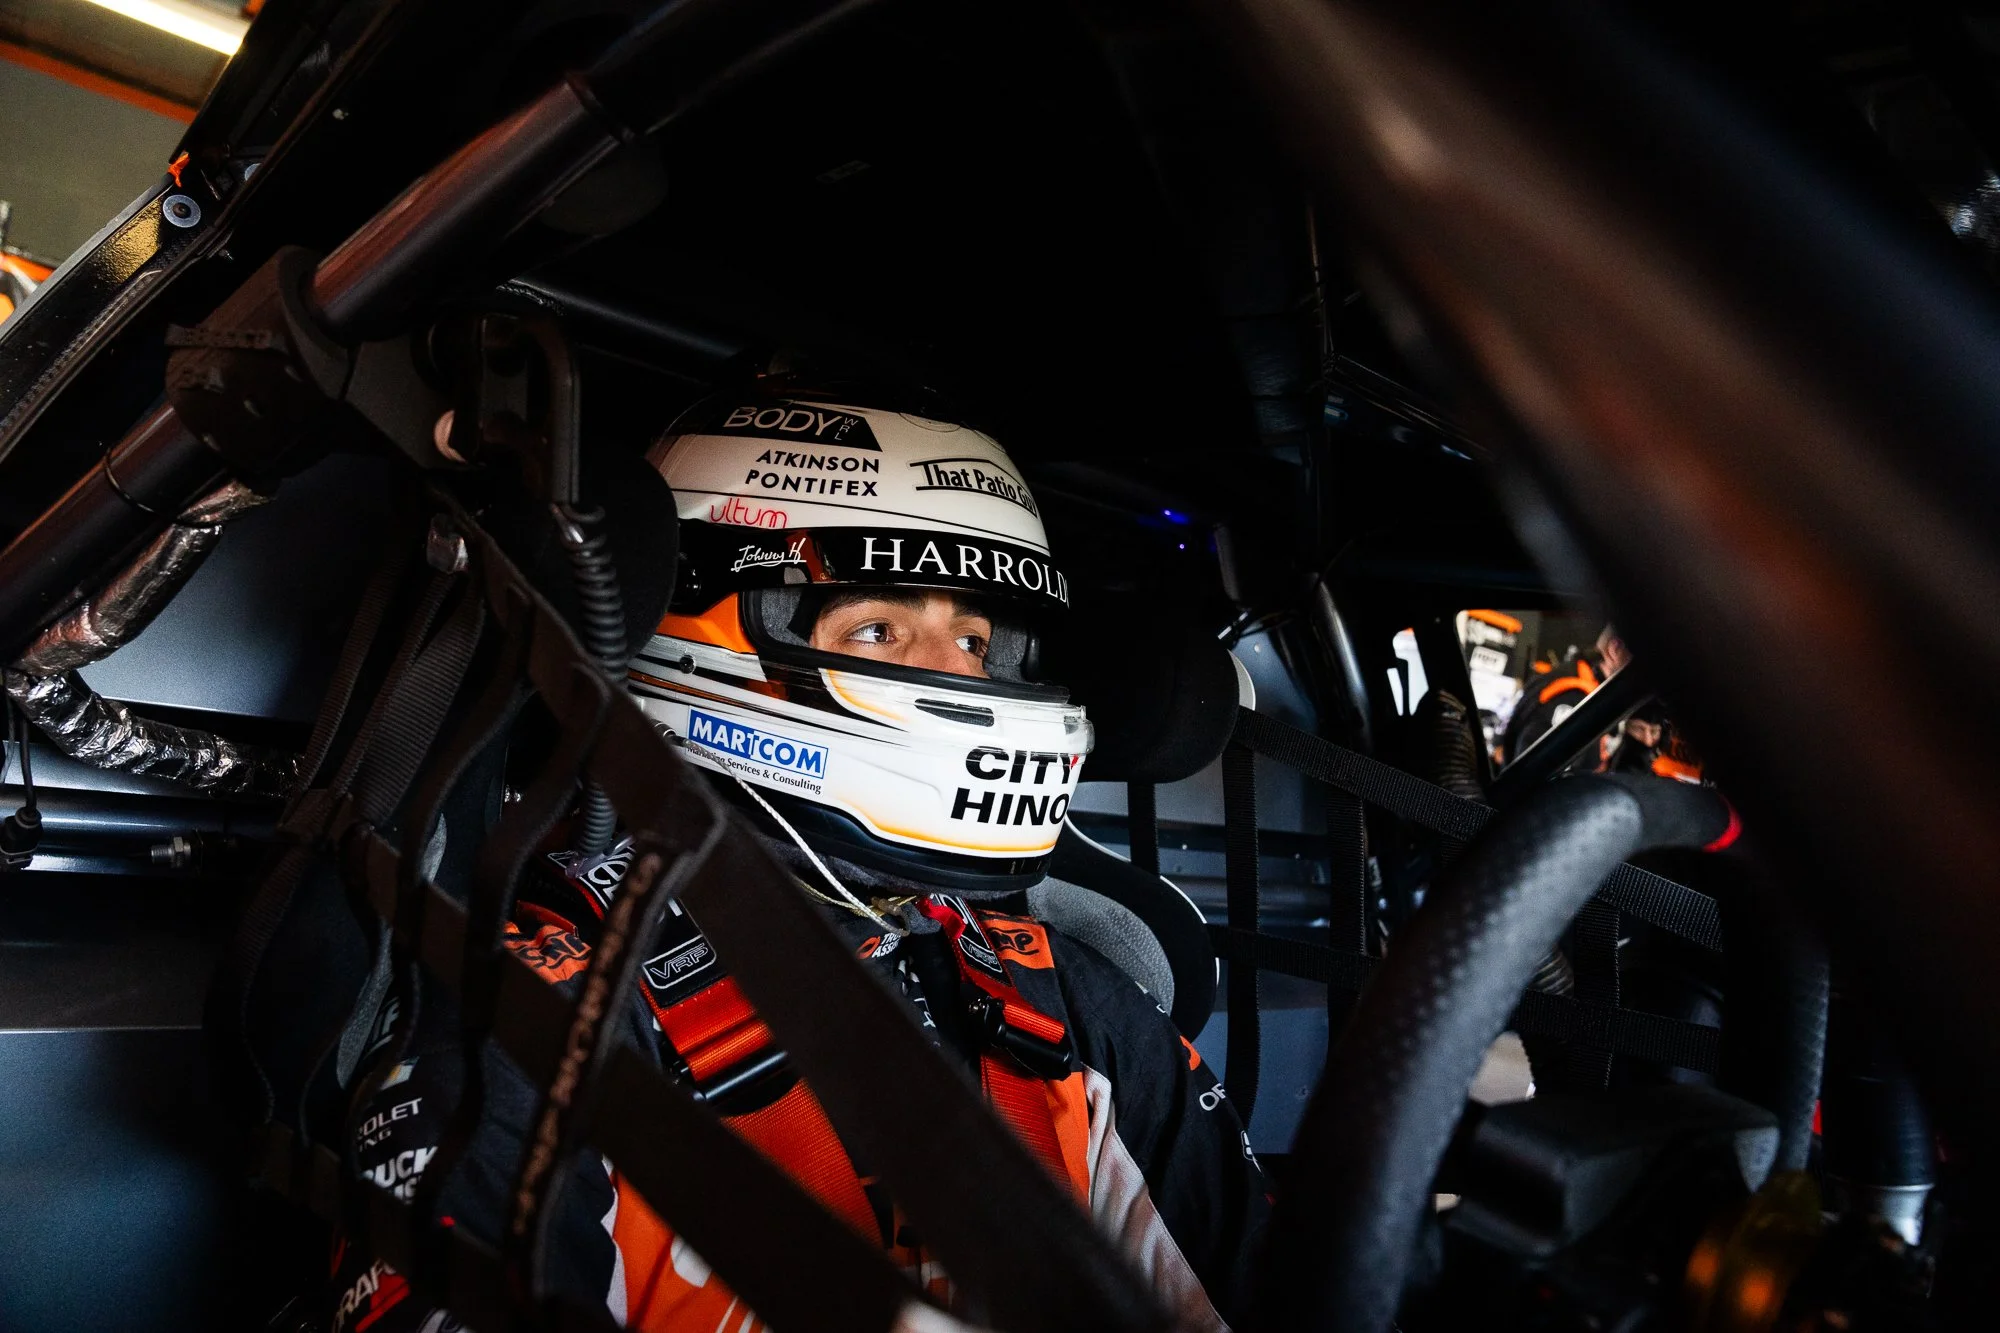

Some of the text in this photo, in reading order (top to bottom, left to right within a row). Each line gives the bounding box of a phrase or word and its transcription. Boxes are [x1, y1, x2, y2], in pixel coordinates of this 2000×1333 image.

[723, 406, 842, 436] BODY
[756, 449, 880, 474] ATKINSON
[745, 469, 878, 497] PONTIFEX
[921, 461, 973, 489] That
[972, 468, 1017, 501] Patio
[710, 497, 788, 529] ultum
[860, 536, 1070, 609] HARROLD
[692, 716, 821, 774] MARTCOM
[726, 757, 761, 776] Services
[762, 769, 771, 779] &
[772, 771, 822, 795] Consulting
[965, 745, 1079, 785] CITY
[950, 786, 1070, 826] HINO
[649, 942, 709, 979] VRP
